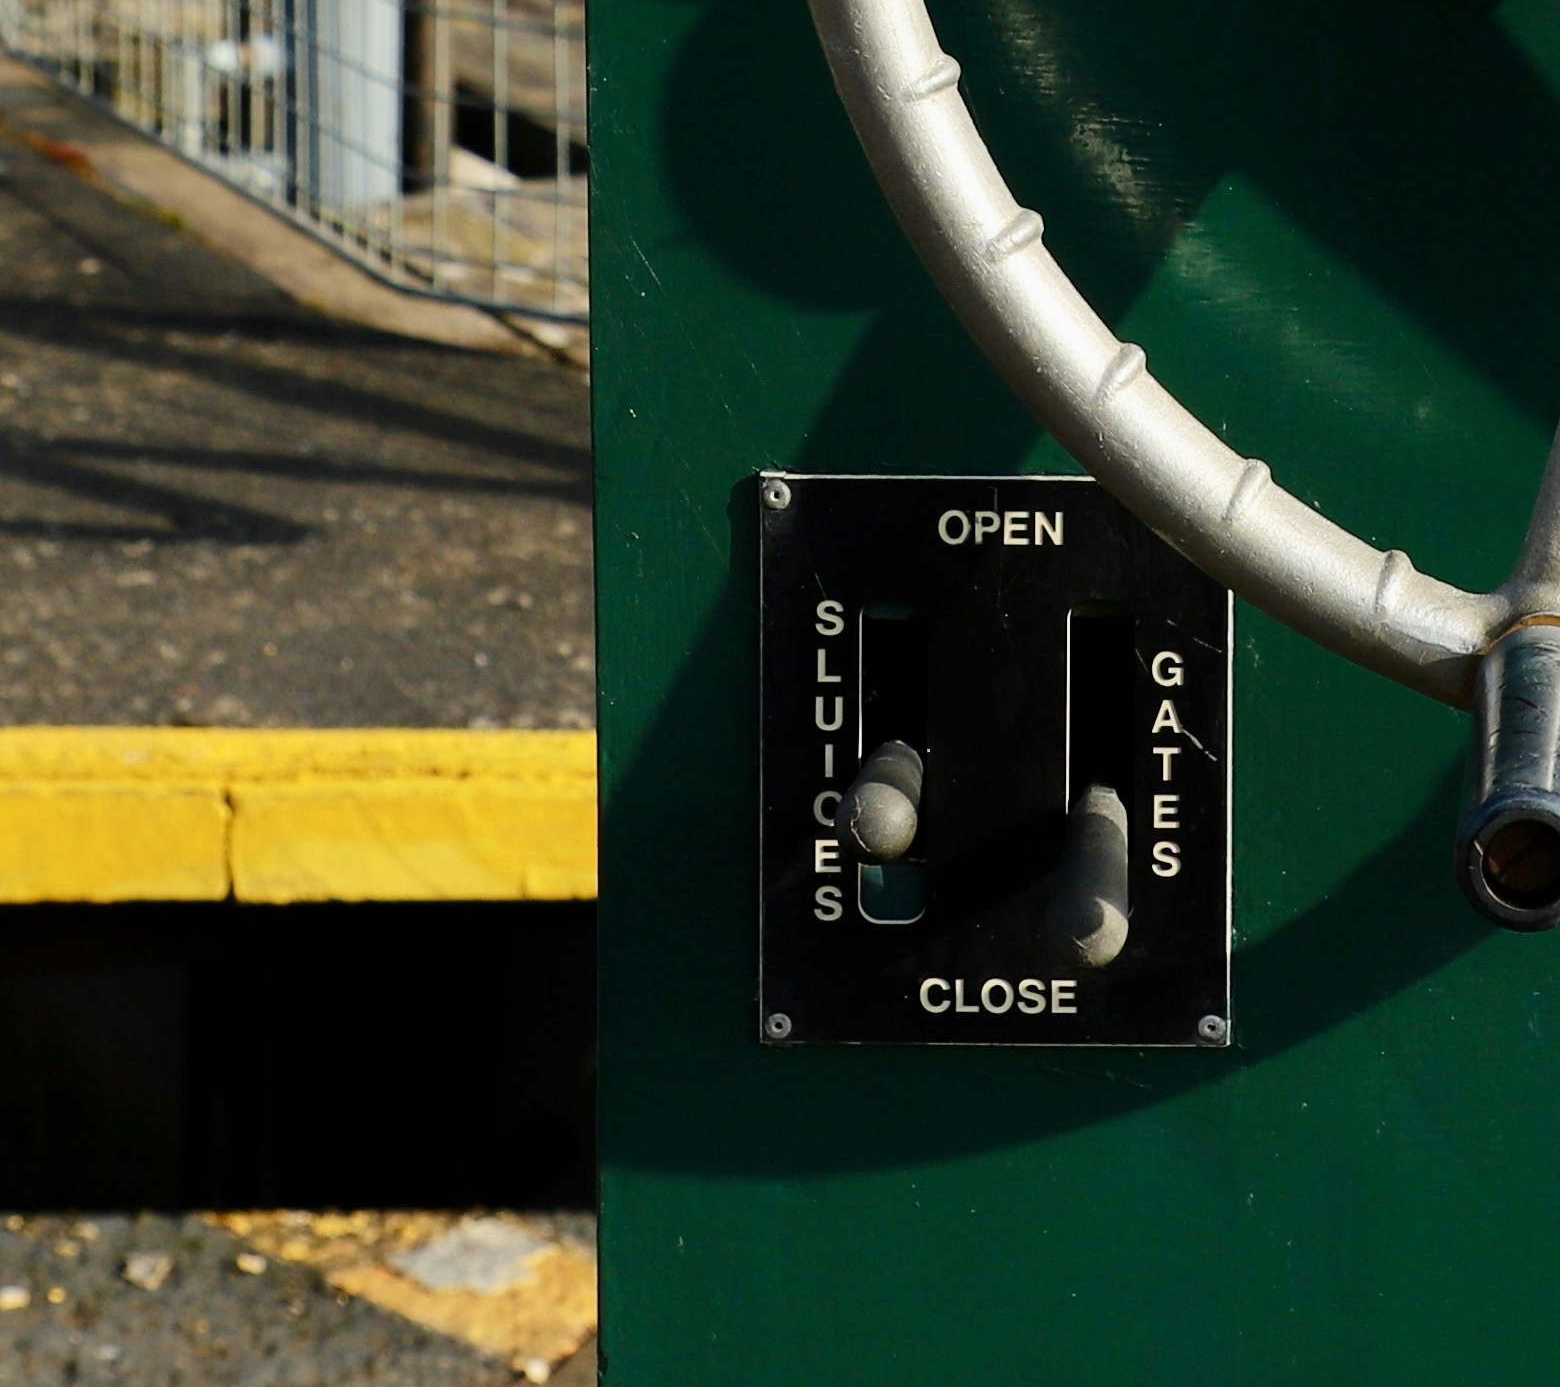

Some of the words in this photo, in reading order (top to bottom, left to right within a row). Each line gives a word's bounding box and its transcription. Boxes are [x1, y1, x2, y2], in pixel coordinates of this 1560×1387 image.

[938, 509, 1065, 546] OPEN
[813, 599, 845, 922] SLUICES
[1151, 650, 1184, 878] GATES
[919, 977, 1078, 1015] CLOSE
